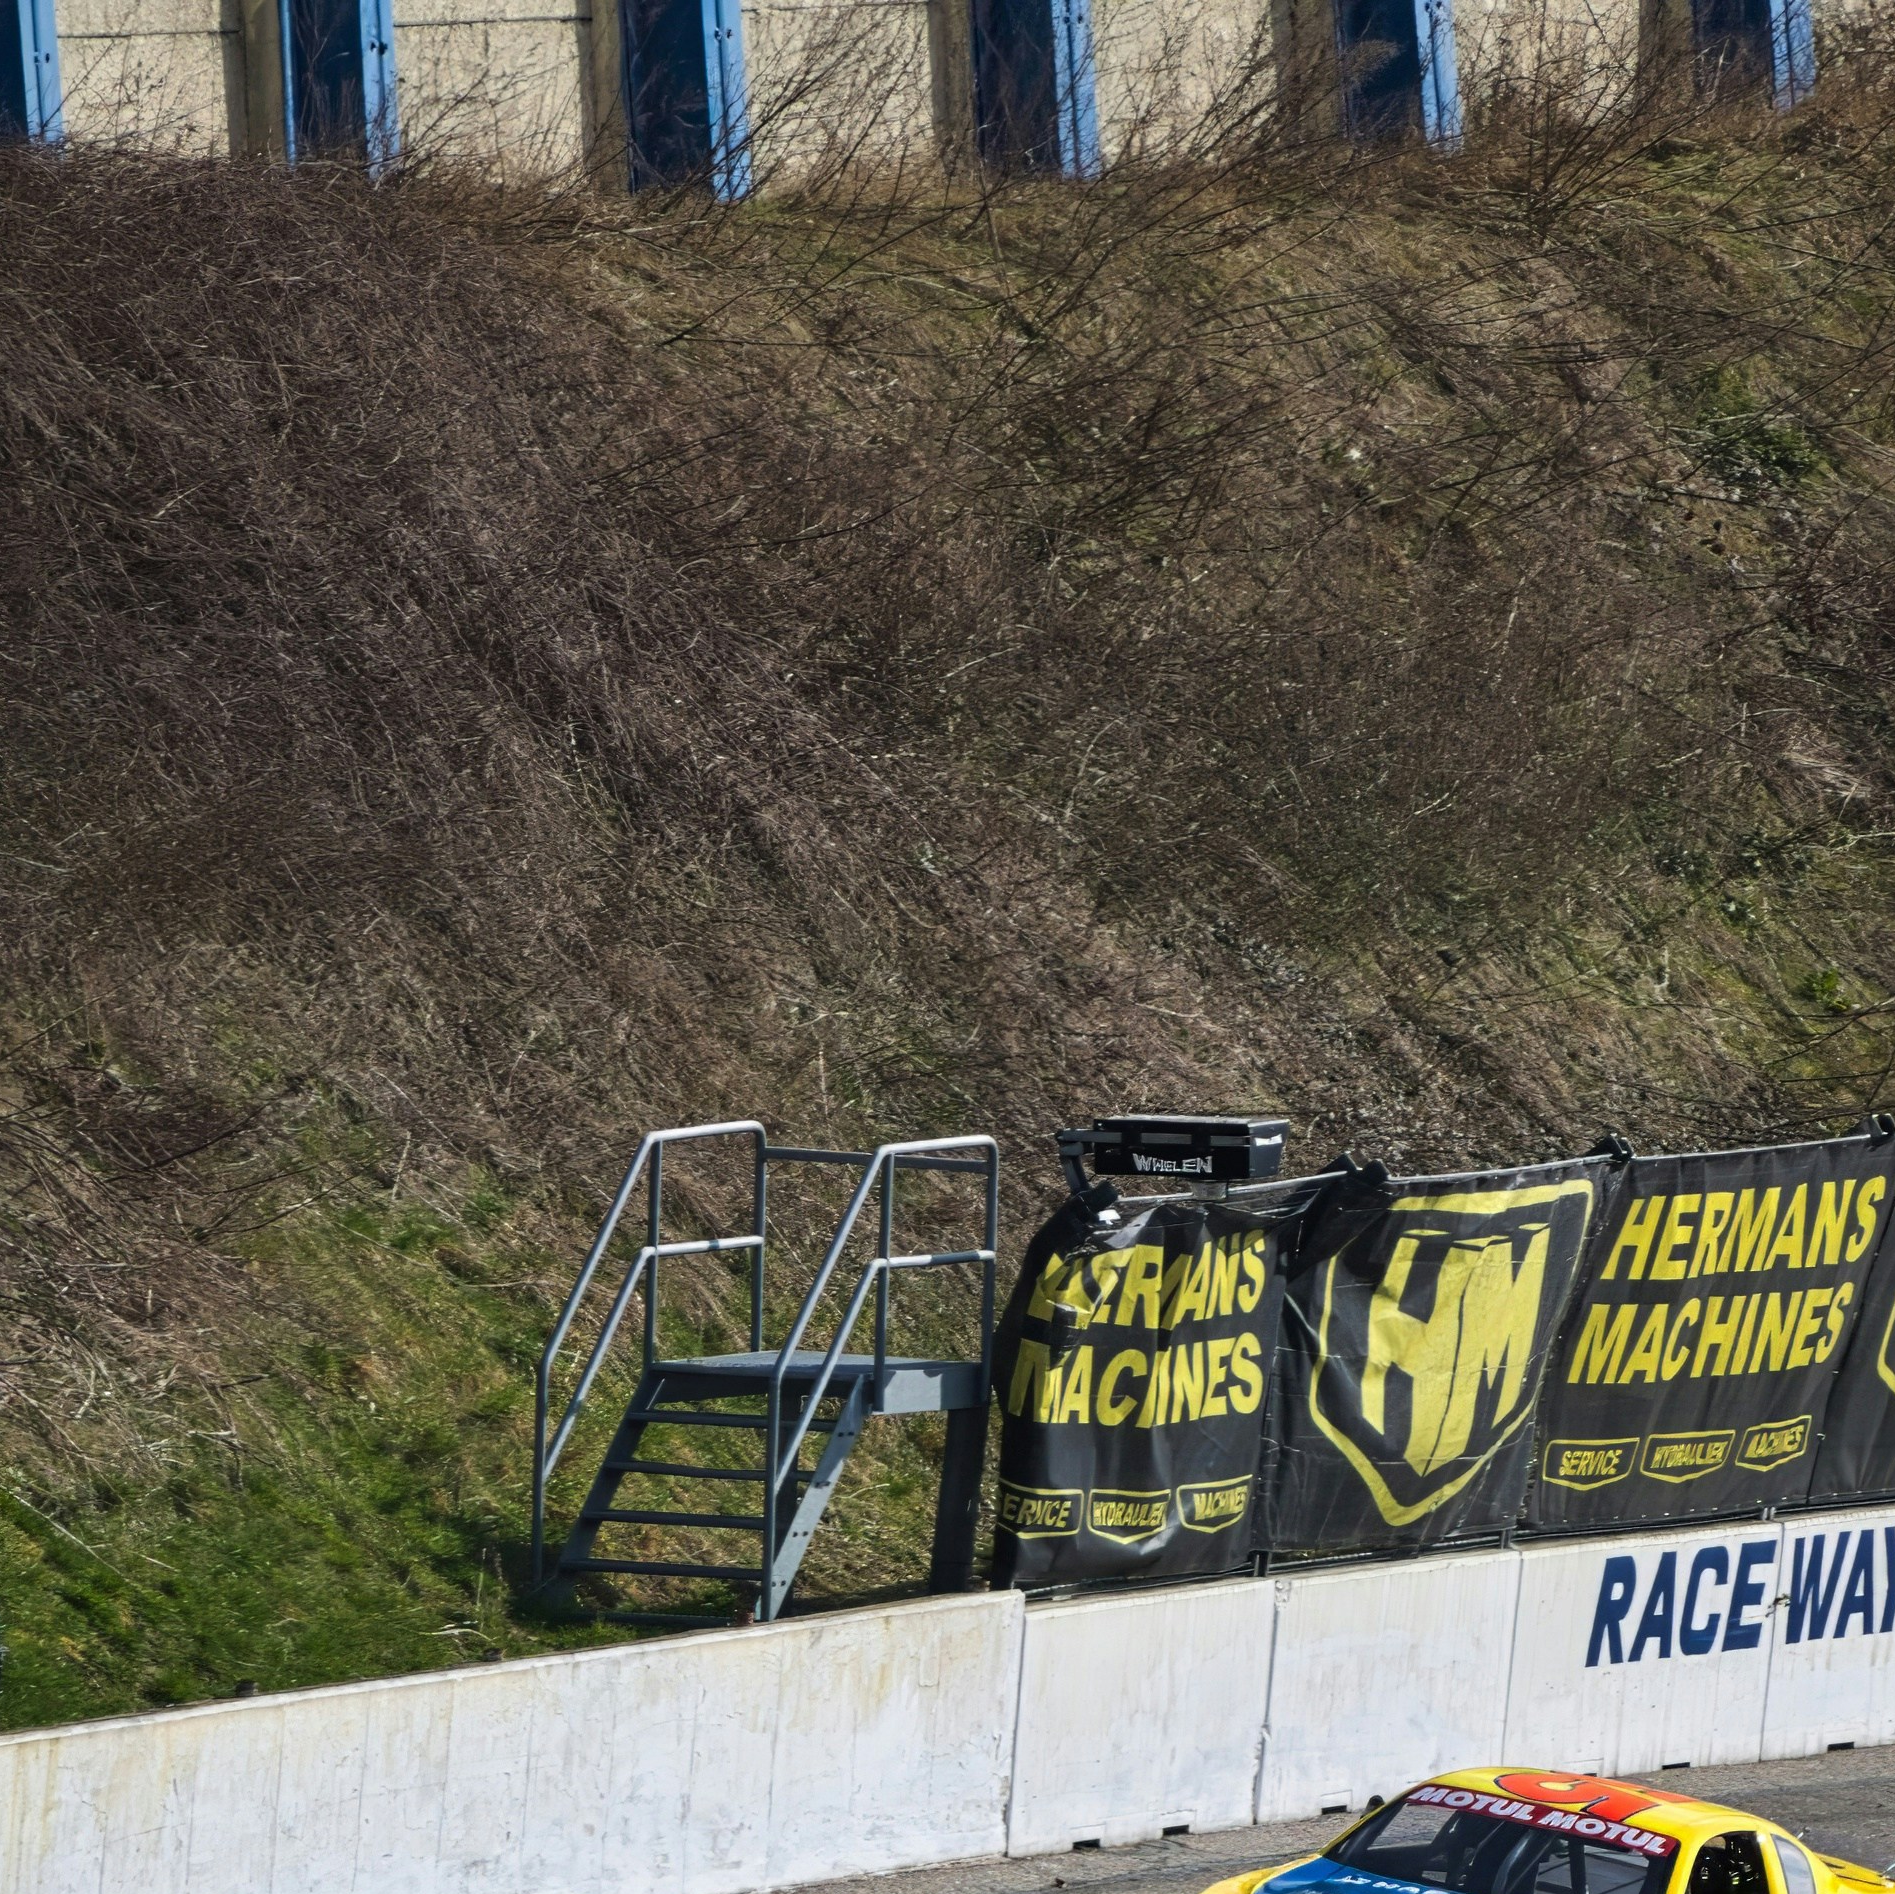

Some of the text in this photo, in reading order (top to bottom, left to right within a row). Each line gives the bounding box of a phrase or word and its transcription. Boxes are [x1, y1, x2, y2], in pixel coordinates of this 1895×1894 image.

[1133, 1153, 1213, 1174] WHELEN
[1600, 1175, 1886, 1280] HERMANS
[1567, 1282, 1854, 1384] MACHINES
[1559, 1449, 1623, 1476] SERVICE
[1408, 1786, 1666, 1855] MOTUL MOTUL
